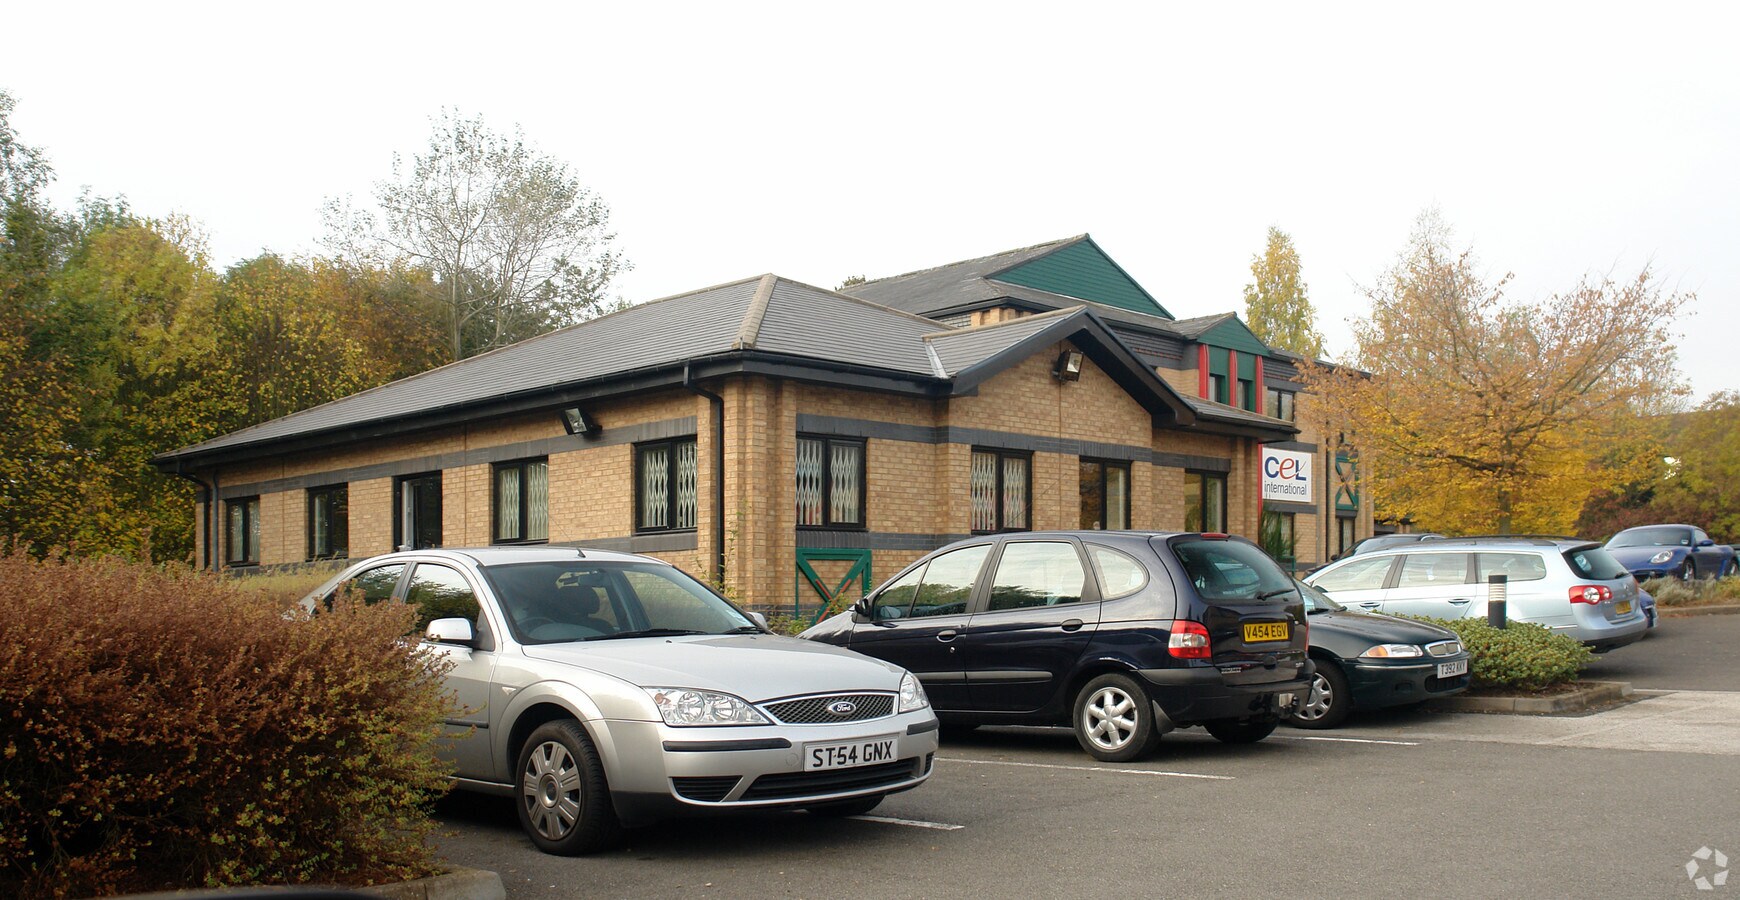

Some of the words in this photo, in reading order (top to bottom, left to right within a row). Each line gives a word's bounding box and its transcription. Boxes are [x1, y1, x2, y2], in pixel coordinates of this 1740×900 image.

[1264, 481, 1307, 495] international
[1245, 625, 1269, 638] V454
[1271, 624, 1286, 637] EGV
[1441, 662, 1455, 675] T392
[837, 704, 851, 712] Ford
[813, 746, 857, 768] ST54
[863, 741, 893, 762] GNX
